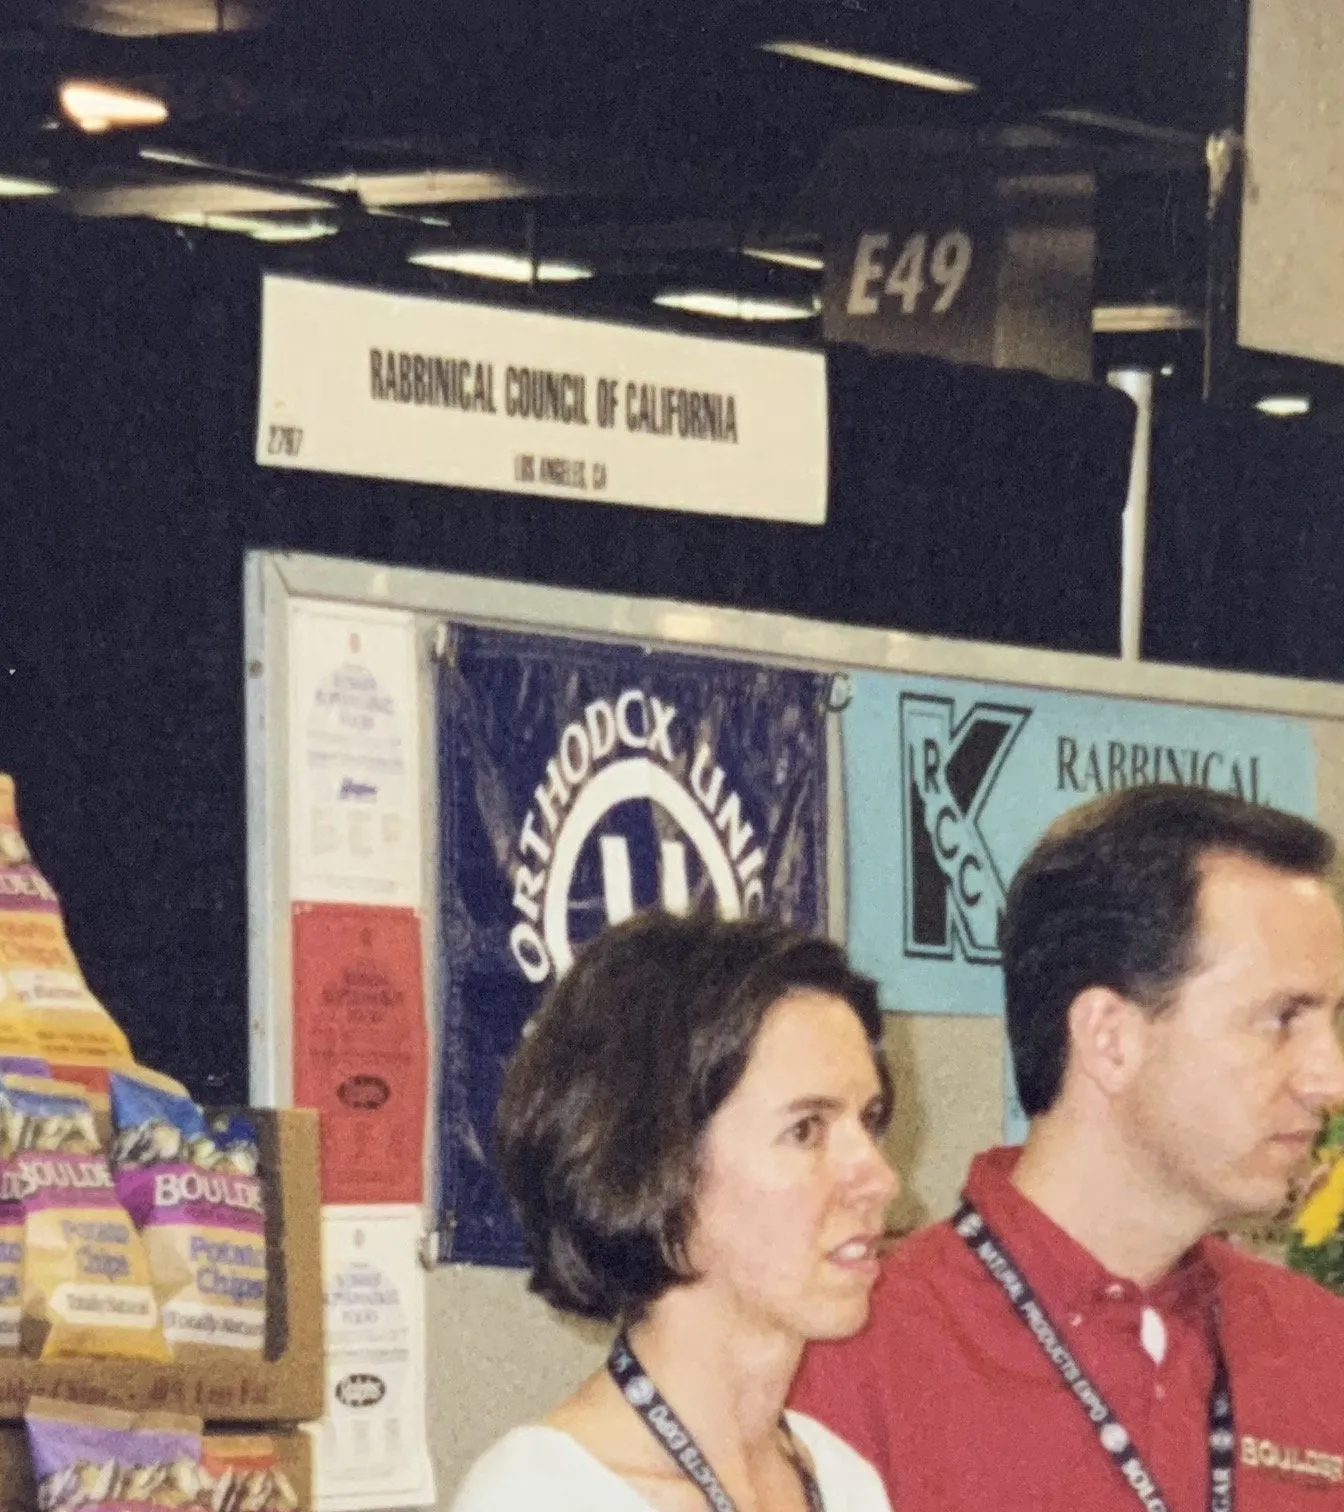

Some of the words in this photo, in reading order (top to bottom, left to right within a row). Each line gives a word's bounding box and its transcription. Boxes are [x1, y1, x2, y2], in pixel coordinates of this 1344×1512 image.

[846, 228, 972, 316] E49
[369, 347, 497, 415] RABBINICAL
[504, 364, 588, 427] COUNCIL
[596, 376, 620, 430] OF
[624, 379, 739, 444] CALIFORNIA
[514, 452, 535, 483] LOS
[1056, 734, 1272, 806] RABBINICAL
[508, 688, 677, 985] ORTHODOX
